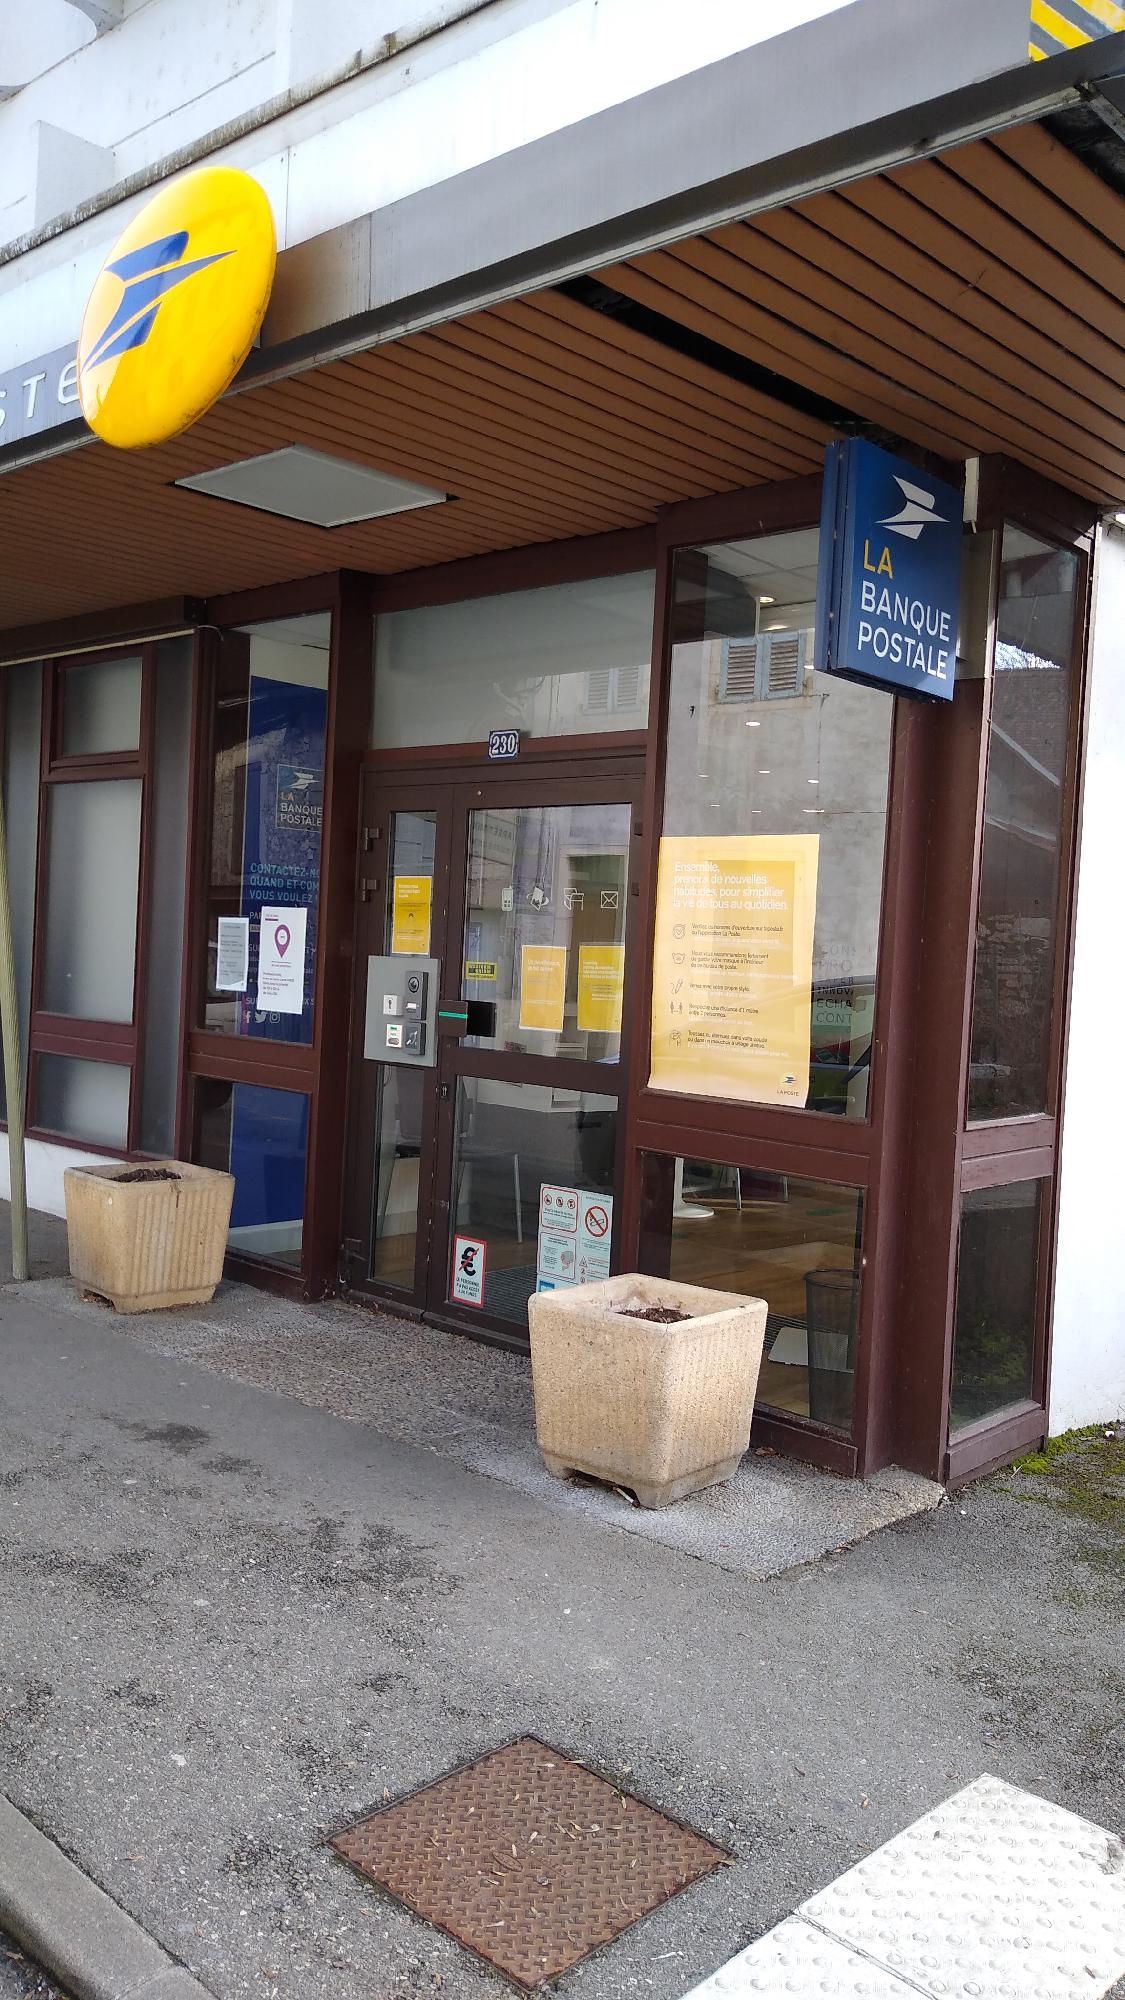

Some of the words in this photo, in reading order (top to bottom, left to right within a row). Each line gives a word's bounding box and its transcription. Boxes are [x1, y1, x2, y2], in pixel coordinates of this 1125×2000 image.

[863, 538, 894, 580] LA
[861, 580, 951, 642] BANQUE
[857, 621, 949, 680] POSTALE
[492, 735, 516, 754] 230
[281, 791, 295, 801] LA
[281, 802, 323, 816] BANQUE
[280, 813, 323, 827] POSTALE
[250, 875, 284, 888] QUAND
[286, 878, 298, 889] ET
[711, 874, 723, 884] de
[724, 874, 768, 885] nouvelles
[250, 890, 274, 900] VOUS
[277, 891, 313, 903] VOULEZ
[719, 888, 741, 898] pour
